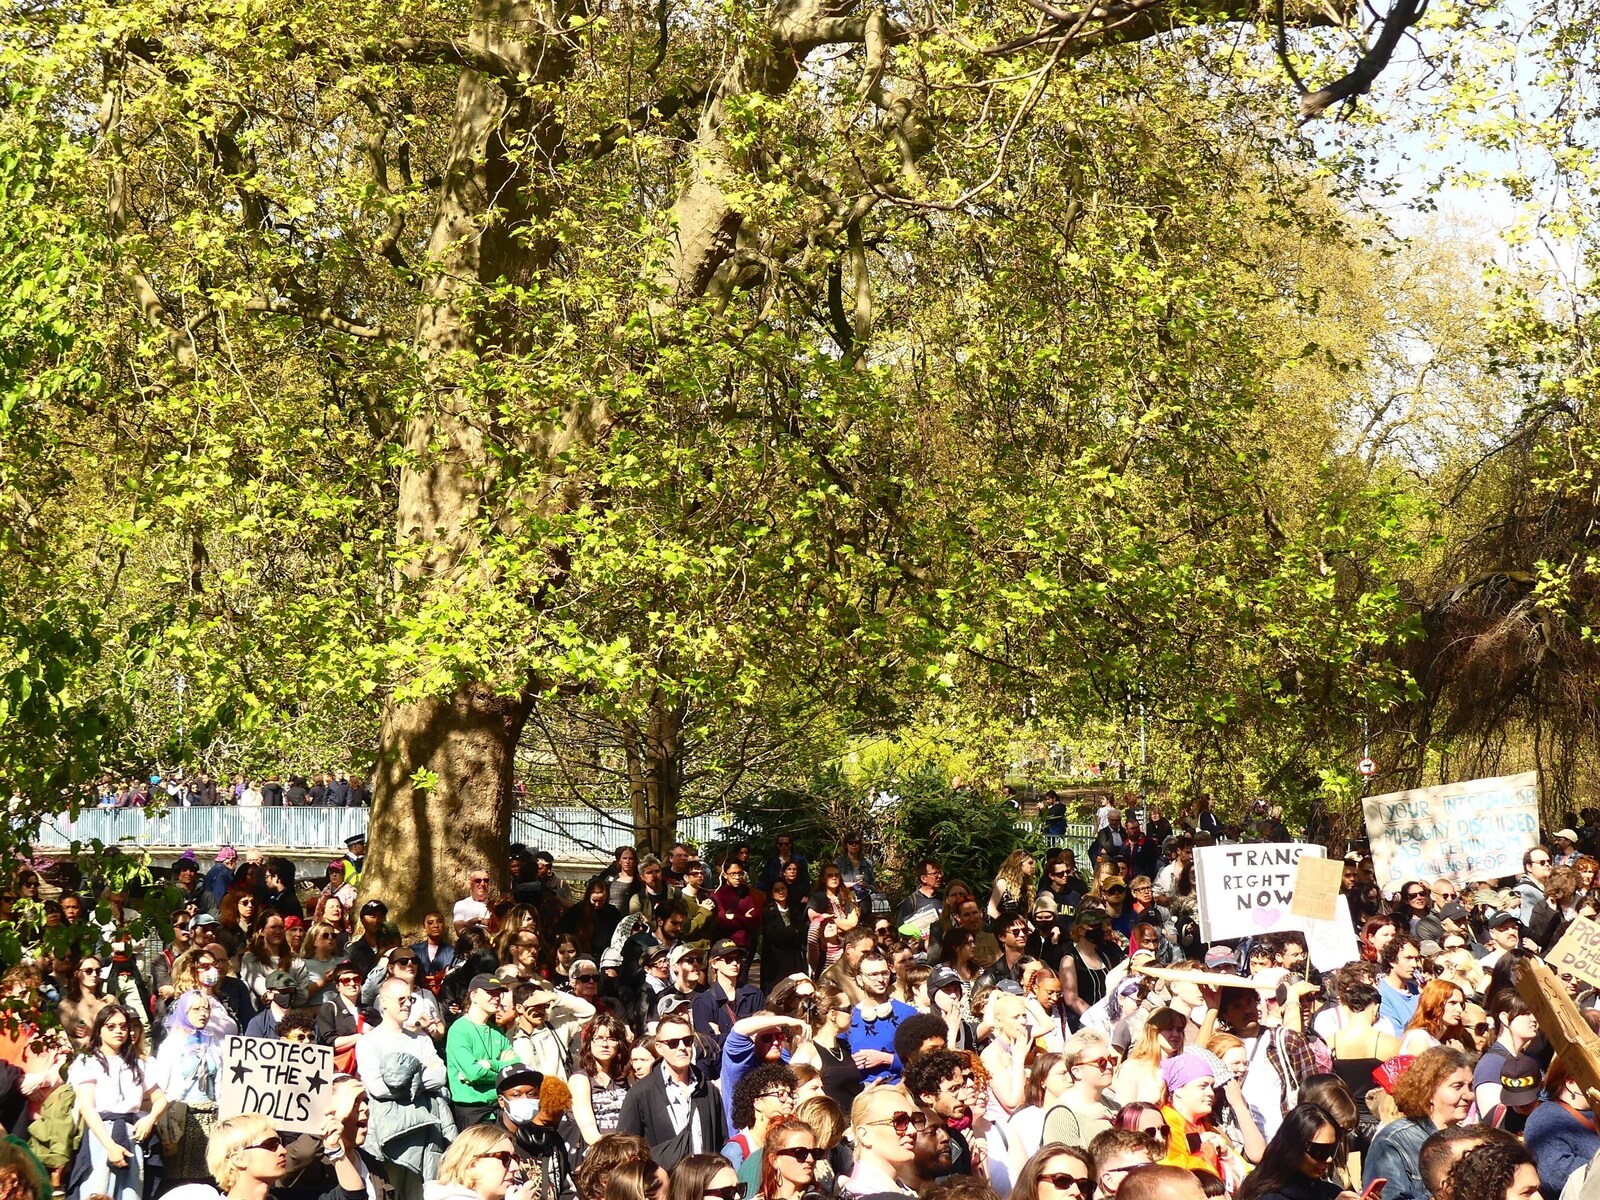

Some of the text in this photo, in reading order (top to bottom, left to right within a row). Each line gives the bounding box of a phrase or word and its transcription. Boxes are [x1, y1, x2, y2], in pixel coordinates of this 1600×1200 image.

[1386, 800, 1430, 821] YOUR
[1226, 848, 1303, 867] TRANS
[1400, 835, 1521, 859] AS FEMINISM
[1389, 851, 1523, 881] IS KILLING PEOPLE
[1223, 874, 1296, 891] RIGHT
[1237, 889, 1293, 910] NOW
[1578, 945, 1600, 965] THE
[1561, 953, 1600, 979] DOLL
[229, 1036, 331, 1070] PROTECT
[260, 1064, 302, 1085] THE
[241, 1085, 311, 1121] DOLLS
